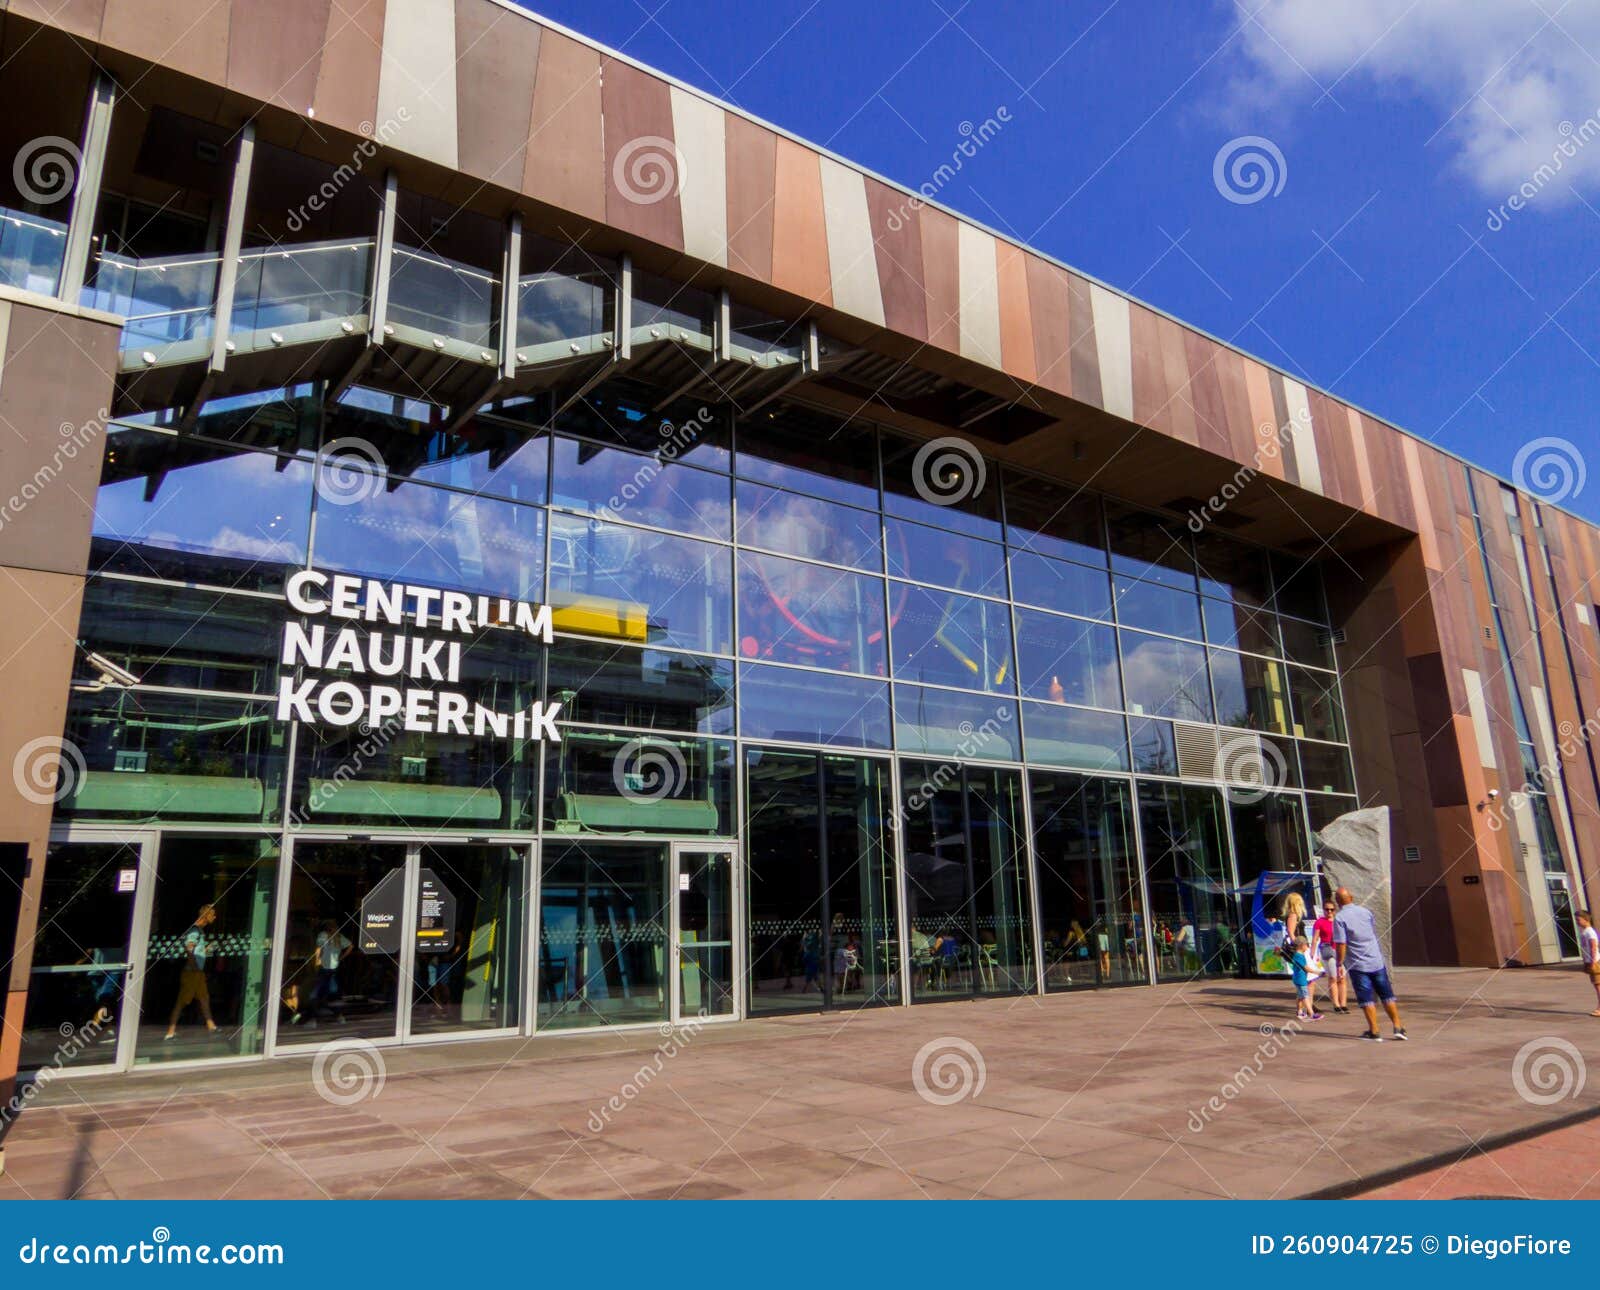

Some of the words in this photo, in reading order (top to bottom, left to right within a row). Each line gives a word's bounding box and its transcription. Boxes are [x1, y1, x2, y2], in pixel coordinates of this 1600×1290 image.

[285, 570, 554, 644] CENTRUM
[282, 621, 461, 682] NAUKI
[277, 676, 563, 742] KOPERNIK
